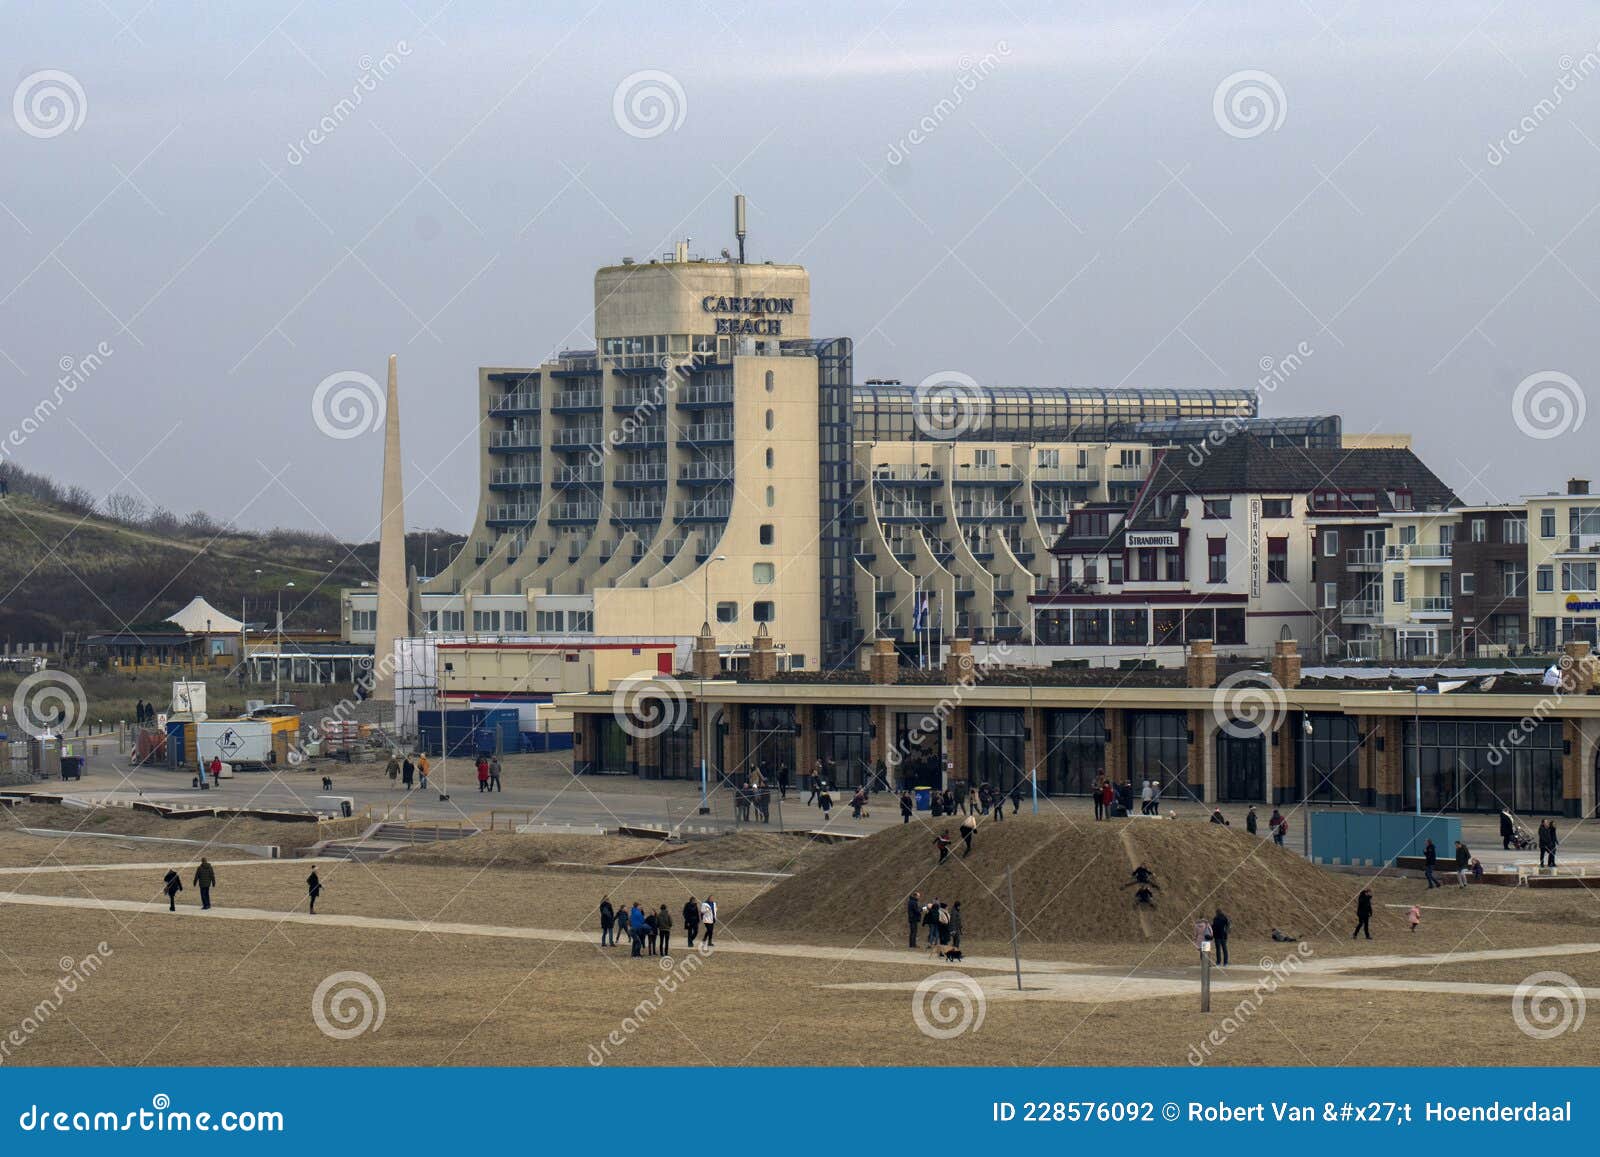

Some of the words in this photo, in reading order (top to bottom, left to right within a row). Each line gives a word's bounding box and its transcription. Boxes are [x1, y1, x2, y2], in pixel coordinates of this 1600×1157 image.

[703, 296, 794, 314] CARLTON
[715, 318, 783, 335] BEACH
[1128, 535, 1174, 546] STRANDHOTEL
